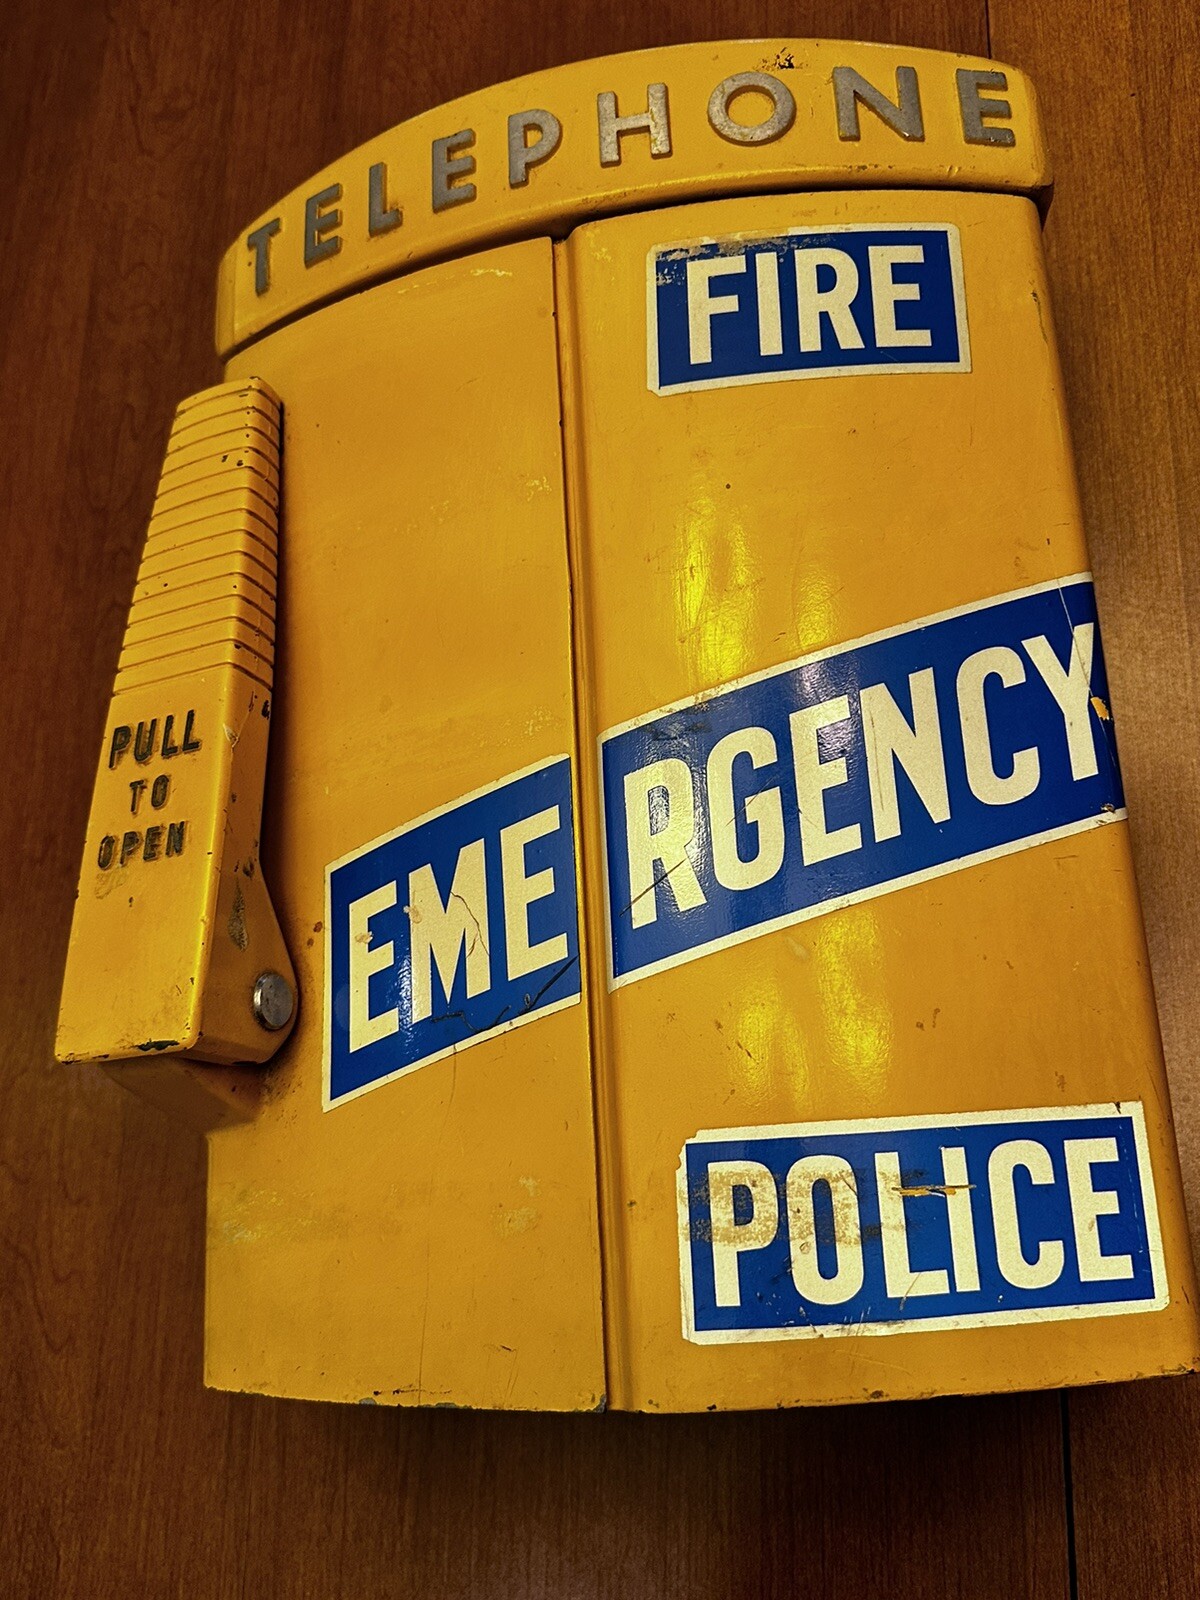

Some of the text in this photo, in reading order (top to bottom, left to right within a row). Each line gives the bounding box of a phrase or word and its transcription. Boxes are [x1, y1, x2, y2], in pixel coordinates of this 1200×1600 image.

[246, 65, 1016, 295] TELEPHONE
[687, 244, 933, 364] FIRE
[108, 709, 201, 769] PULL
[129, 774, 171, 814] TO
[97, 820, 188, 870] OPEN
[707, 1136, 1135, 1308] POLICE
